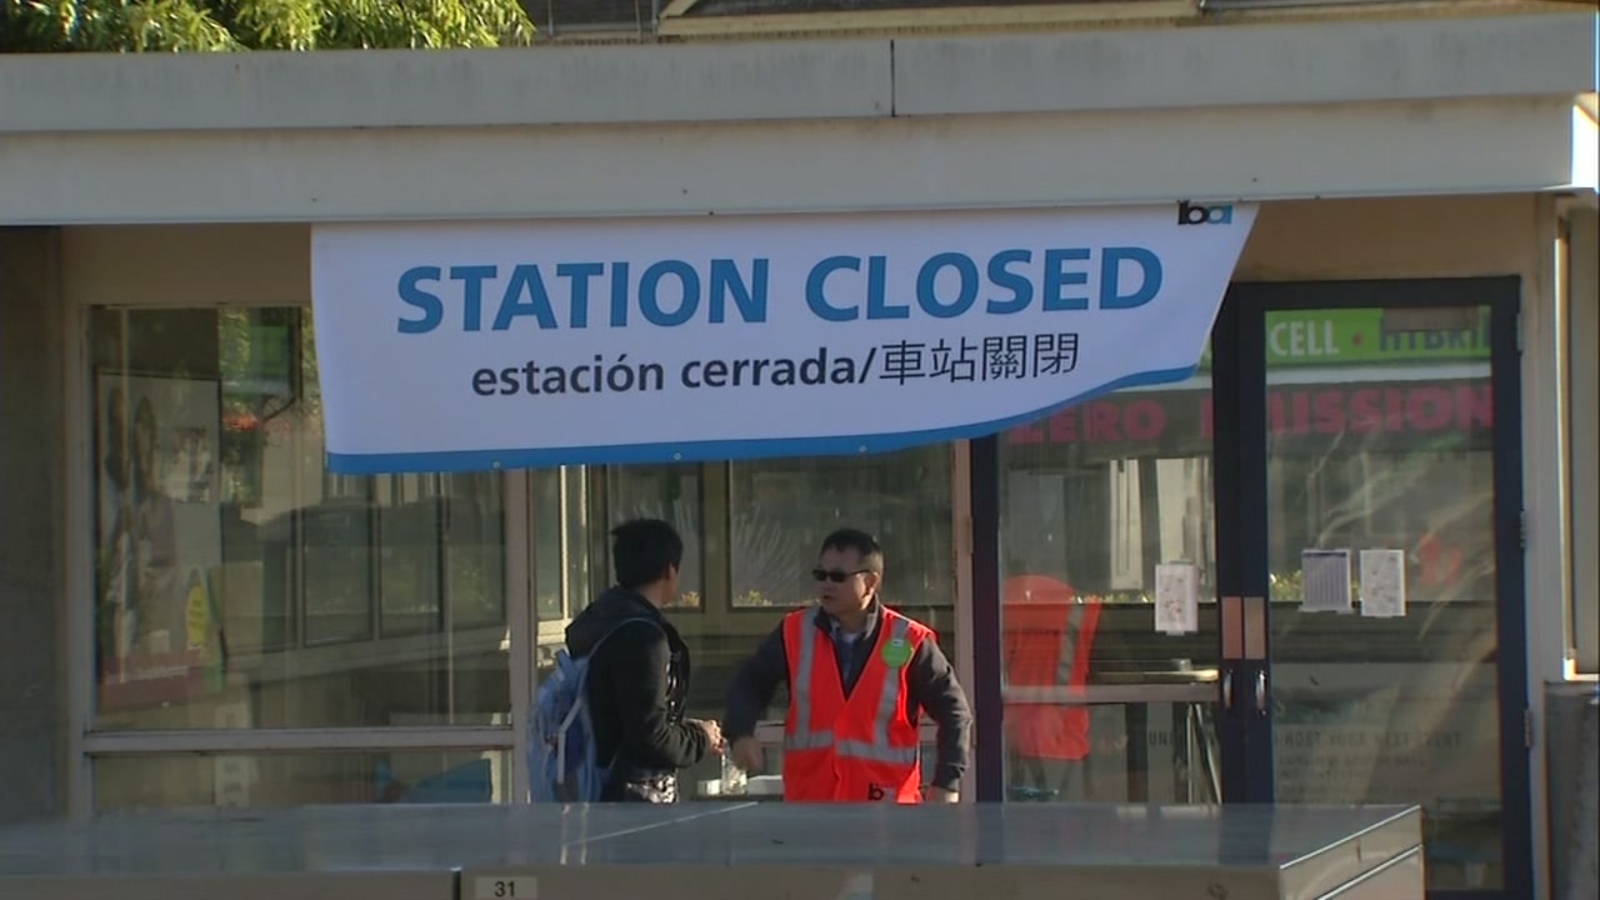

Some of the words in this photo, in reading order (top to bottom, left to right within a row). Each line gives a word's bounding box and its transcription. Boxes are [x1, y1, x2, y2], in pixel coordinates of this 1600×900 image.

[396, 258, 769, 334] STATION
[804, 246, 1164, 322] CLOSED
[1268, 319, 1341, 357] CELL
[472, 353, 664, 397] estación
[495, 880, 515, 898] 31
